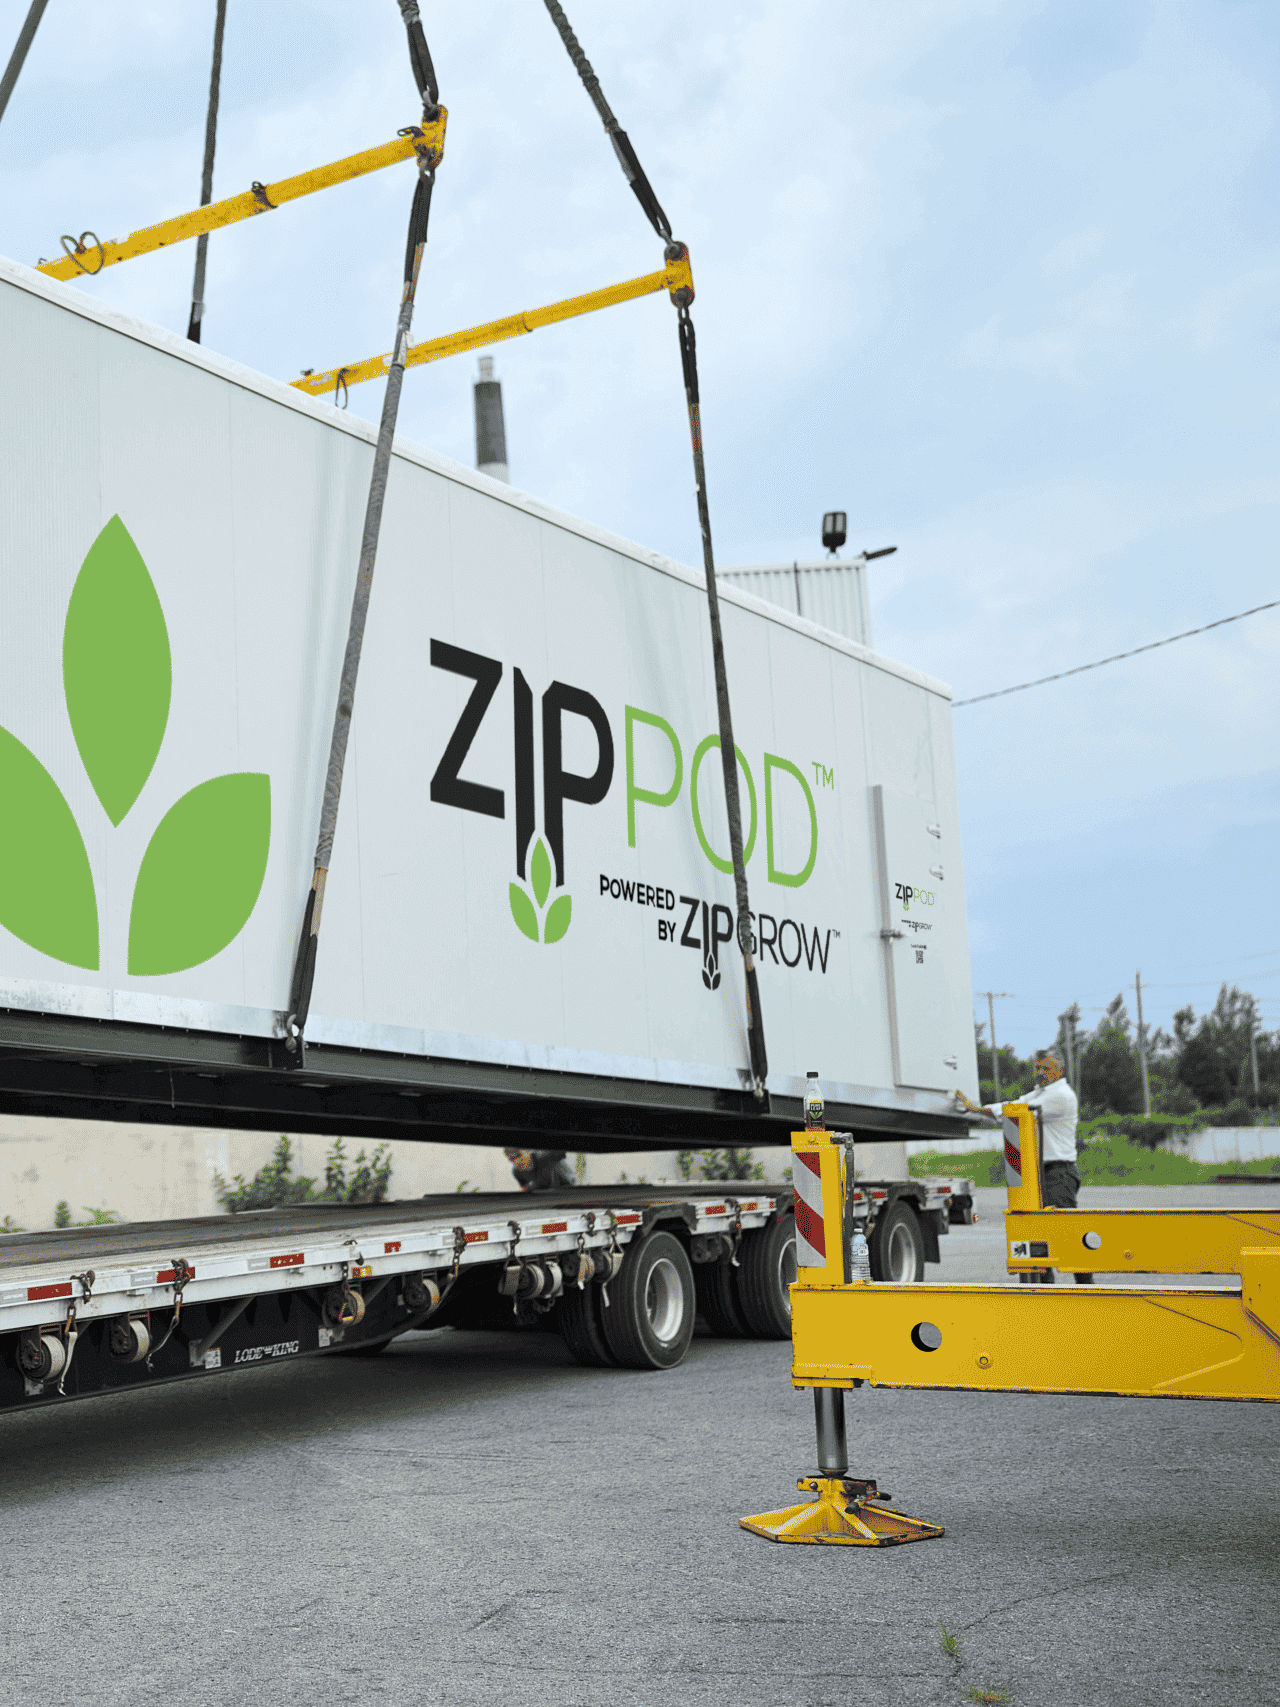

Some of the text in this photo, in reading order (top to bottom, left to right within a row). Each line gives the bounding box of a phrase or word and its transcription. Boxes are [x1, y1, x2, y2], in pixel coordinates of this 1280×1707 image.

[599, 873, 675, 911] POWERED
[658, 918, 677, 942] BY
[234, 1345, 264, 1364] LODE
[271, 1340, 300, 1357] KING
